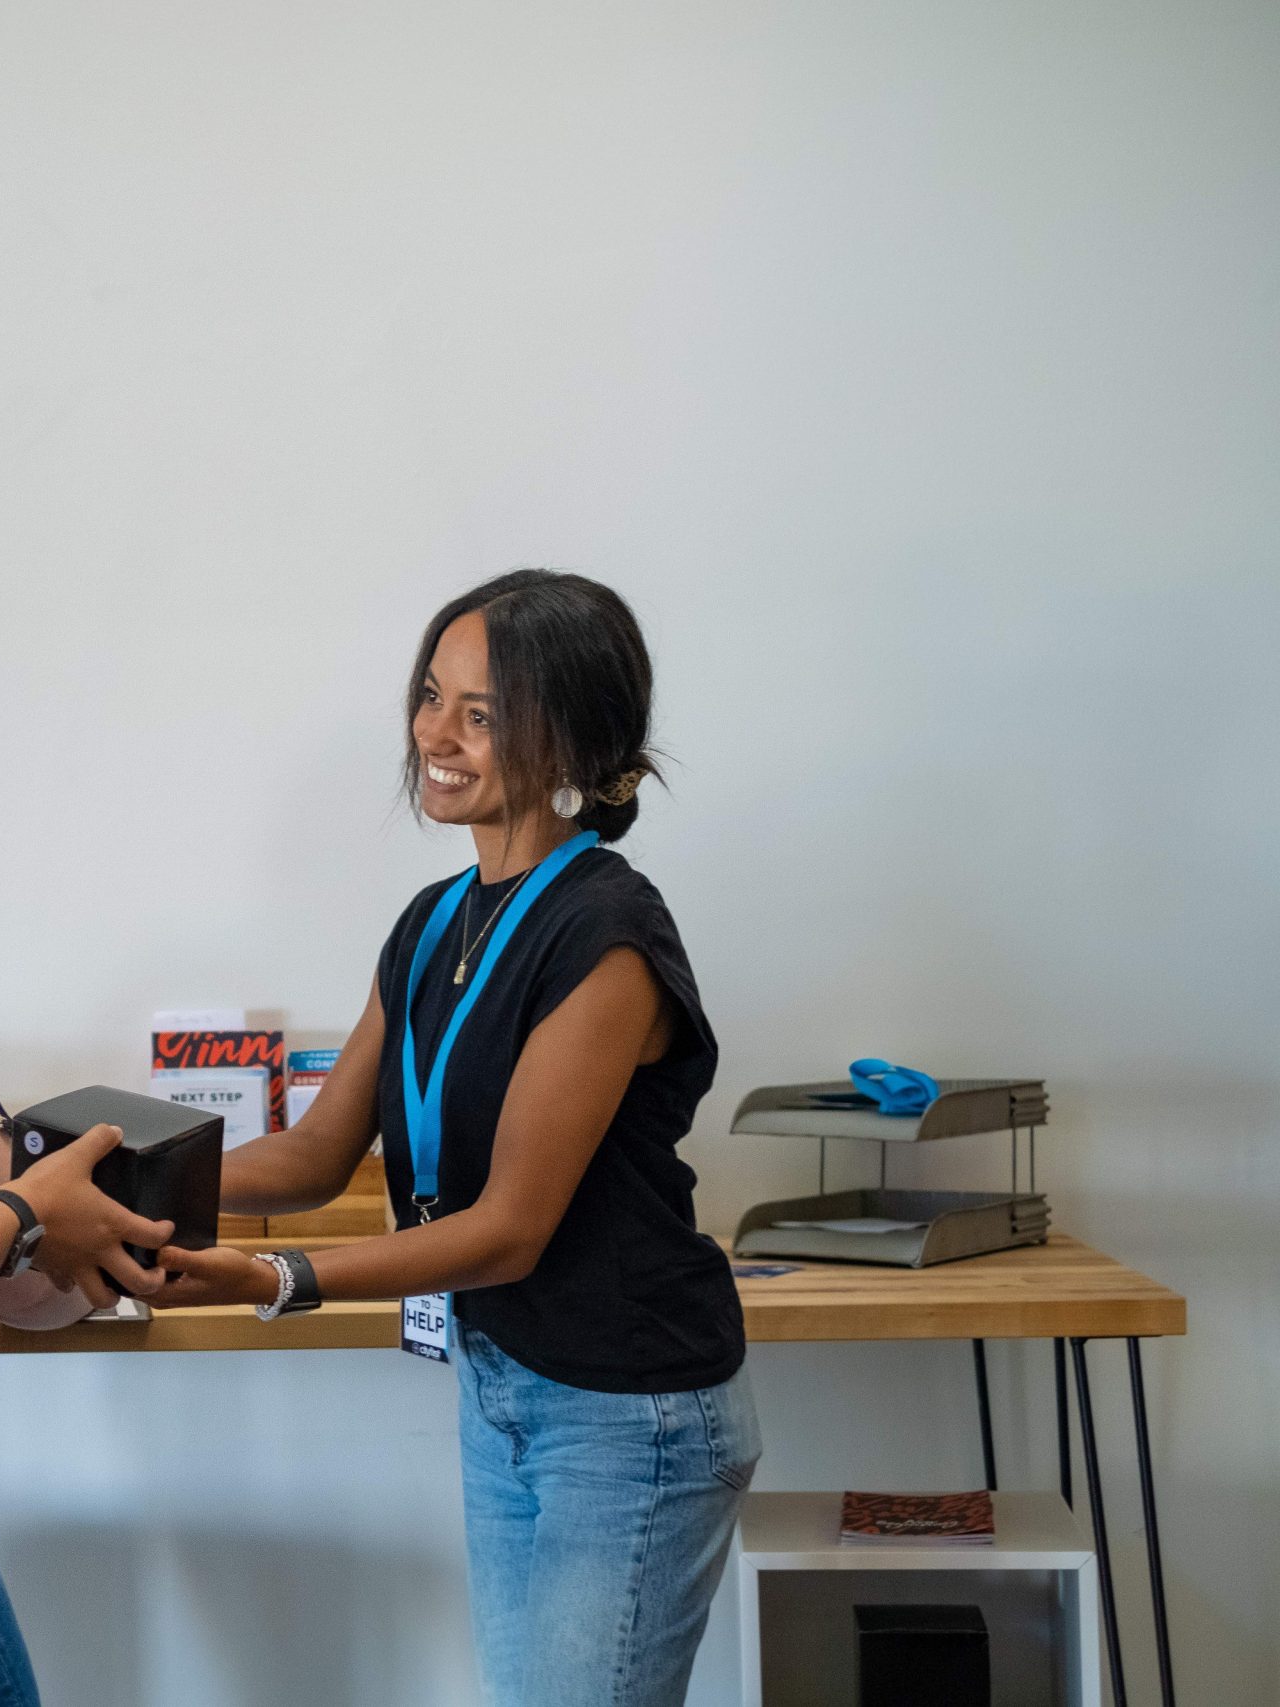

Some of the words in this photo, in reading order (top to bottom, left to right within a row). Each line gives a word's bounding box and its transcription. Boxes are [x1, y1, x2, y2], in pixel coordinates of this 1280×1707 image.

[170, 1092, 205, 1103] NEXT
[210, 1092, 243, 1103] STEP
[420, 1299, 431, 1310] TO
[406, 1308, 445, 1334] HELP
